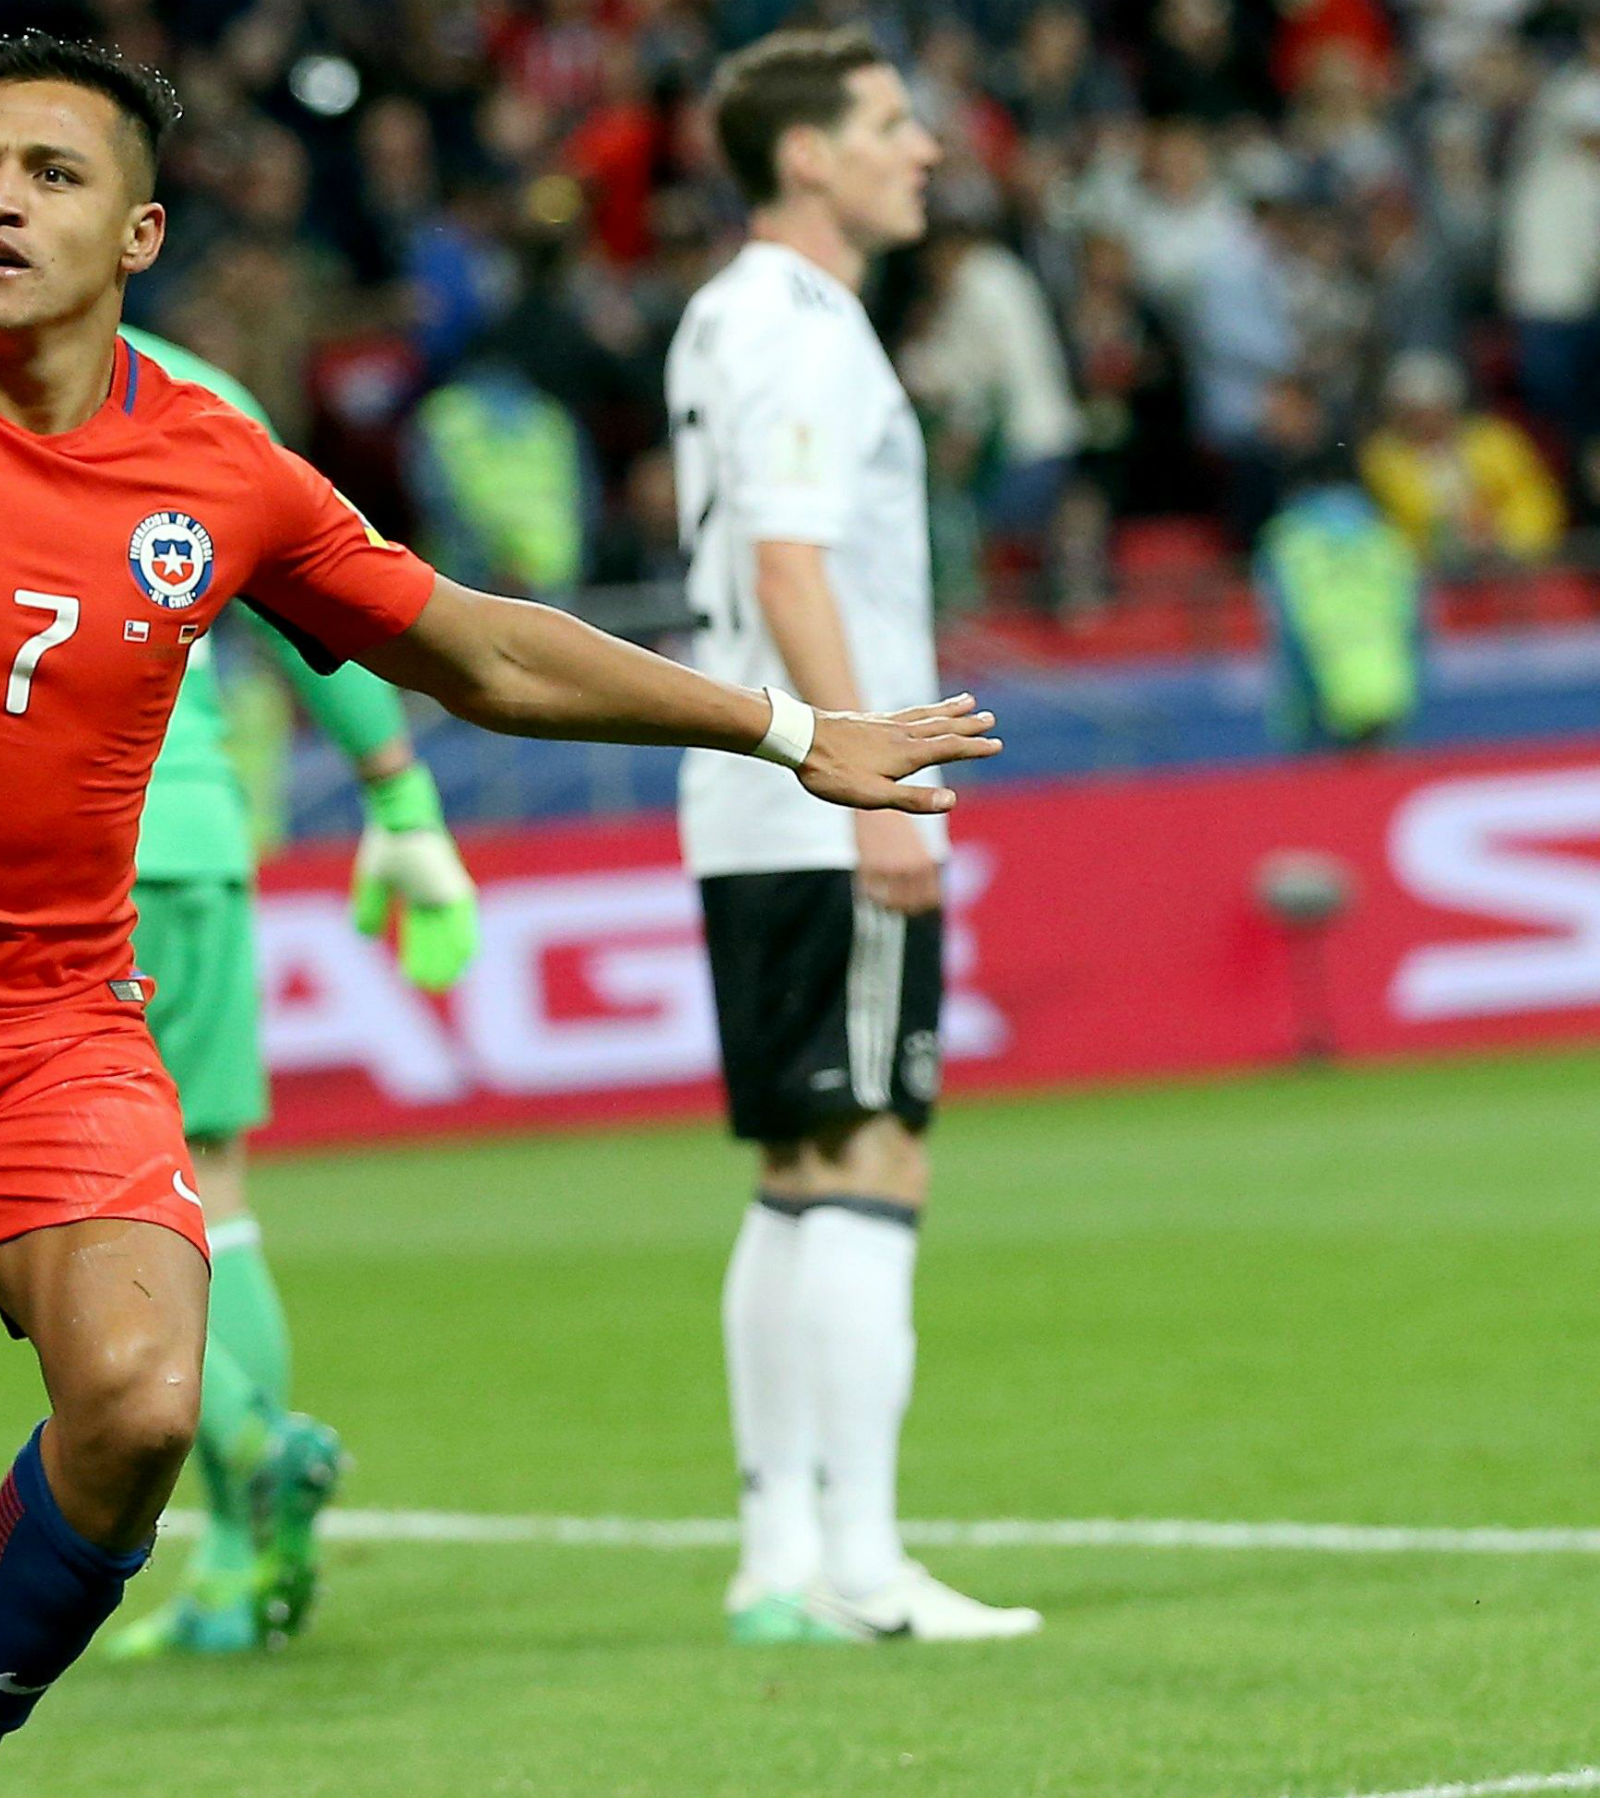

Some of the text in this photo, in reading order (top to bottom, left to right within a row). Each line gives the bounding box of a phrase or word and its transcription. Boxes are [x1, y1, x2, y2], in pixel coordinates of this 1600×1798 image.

[175, 513, 191, 529] DE
[168, 591, 194, 609] CHILE
[5, 588, 80, 715] 7
